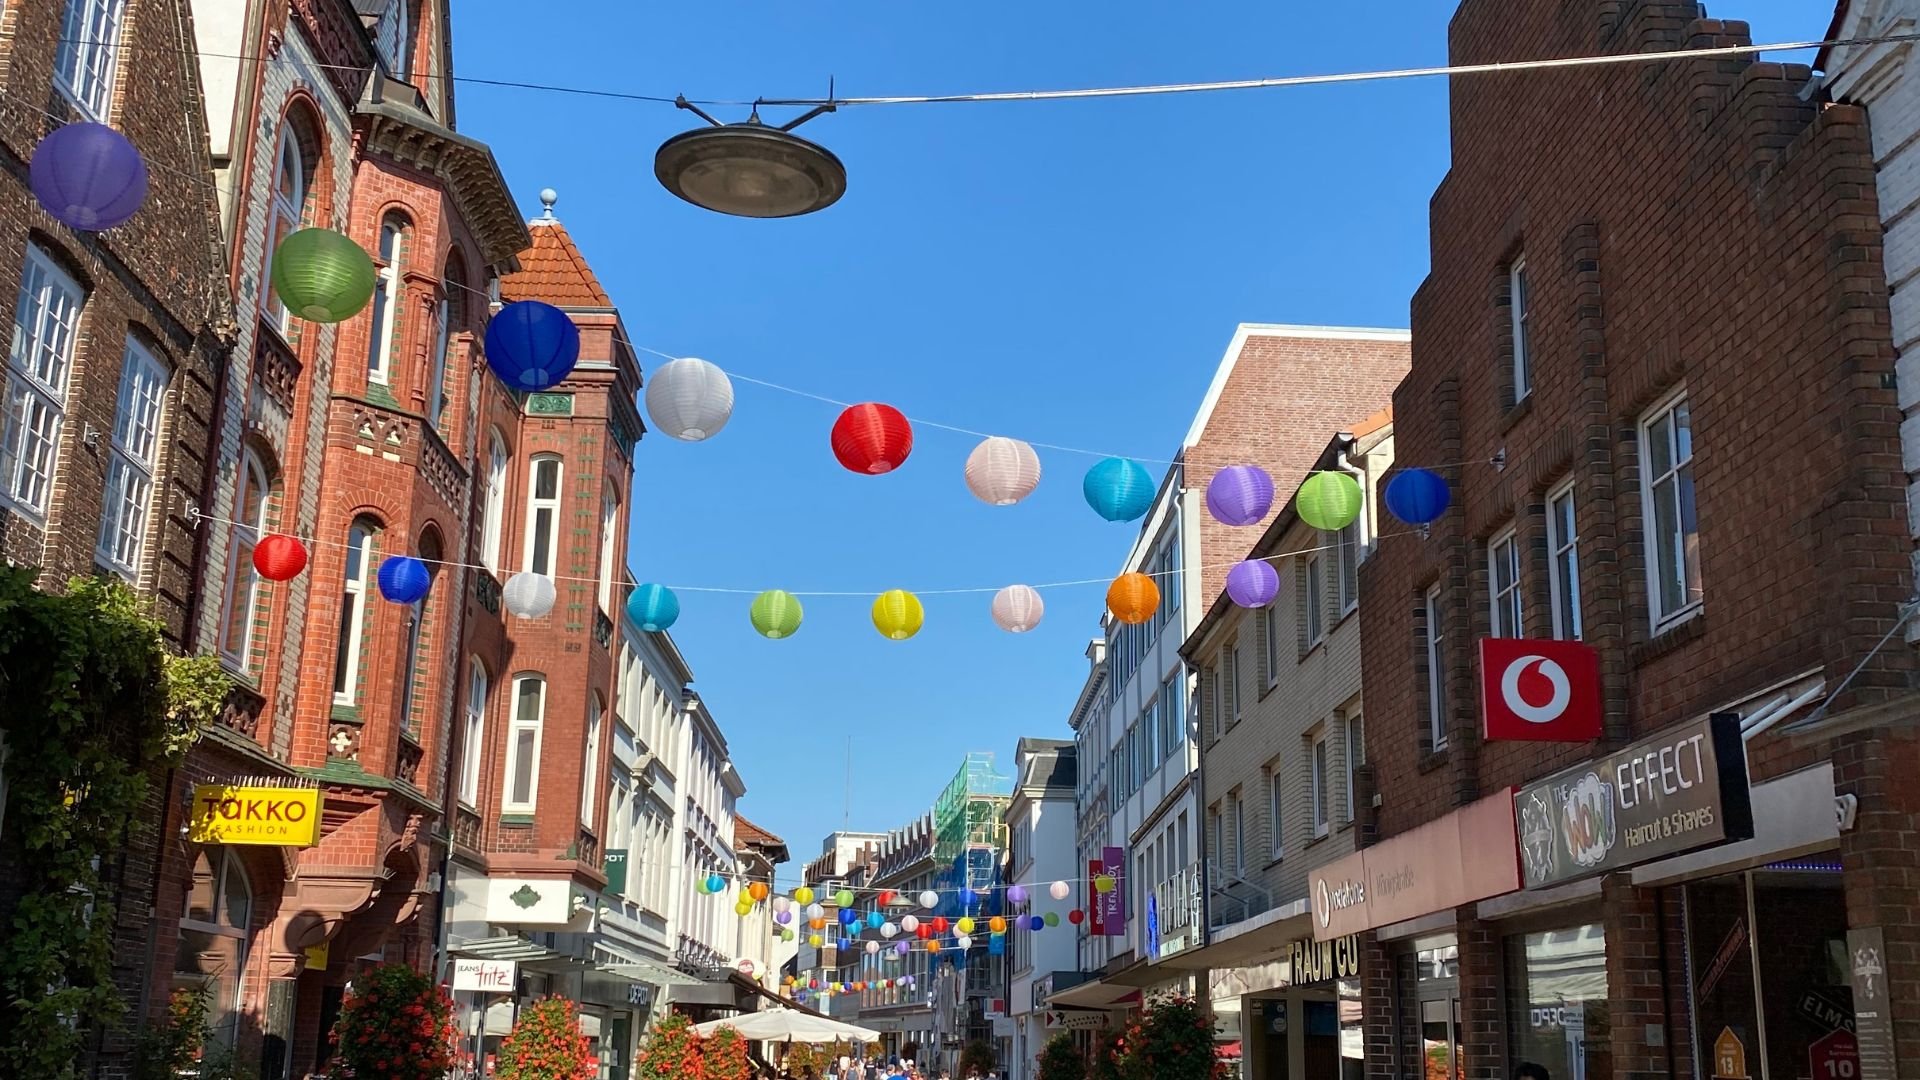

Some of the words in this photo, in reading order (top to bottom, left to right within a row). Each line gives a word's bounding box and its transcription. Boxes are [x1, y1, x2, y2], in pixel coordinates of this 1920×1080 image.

[1552, 784, 1569, 802] THE
[1617, 734, 1704, 810] EFFECT
[215, 824, 288, 835] FASHION
[1624, 822, 1663, 848] Haircut
[1662, 816, 1673, 837] &
[1329, 879, 1366, 912] vodafone
[1286, 934, 1333, 986] TRAUM
[1335, 932, 1360, 977] CU
[458, 965, 480, 973] JEANS
[475, 962, 511, 988] fritz
[629, 984, 648, 1005] DEPOT
[1720, 1057, 1734, 1074] 13
[1824, 1060, 1854, 1078] 10
